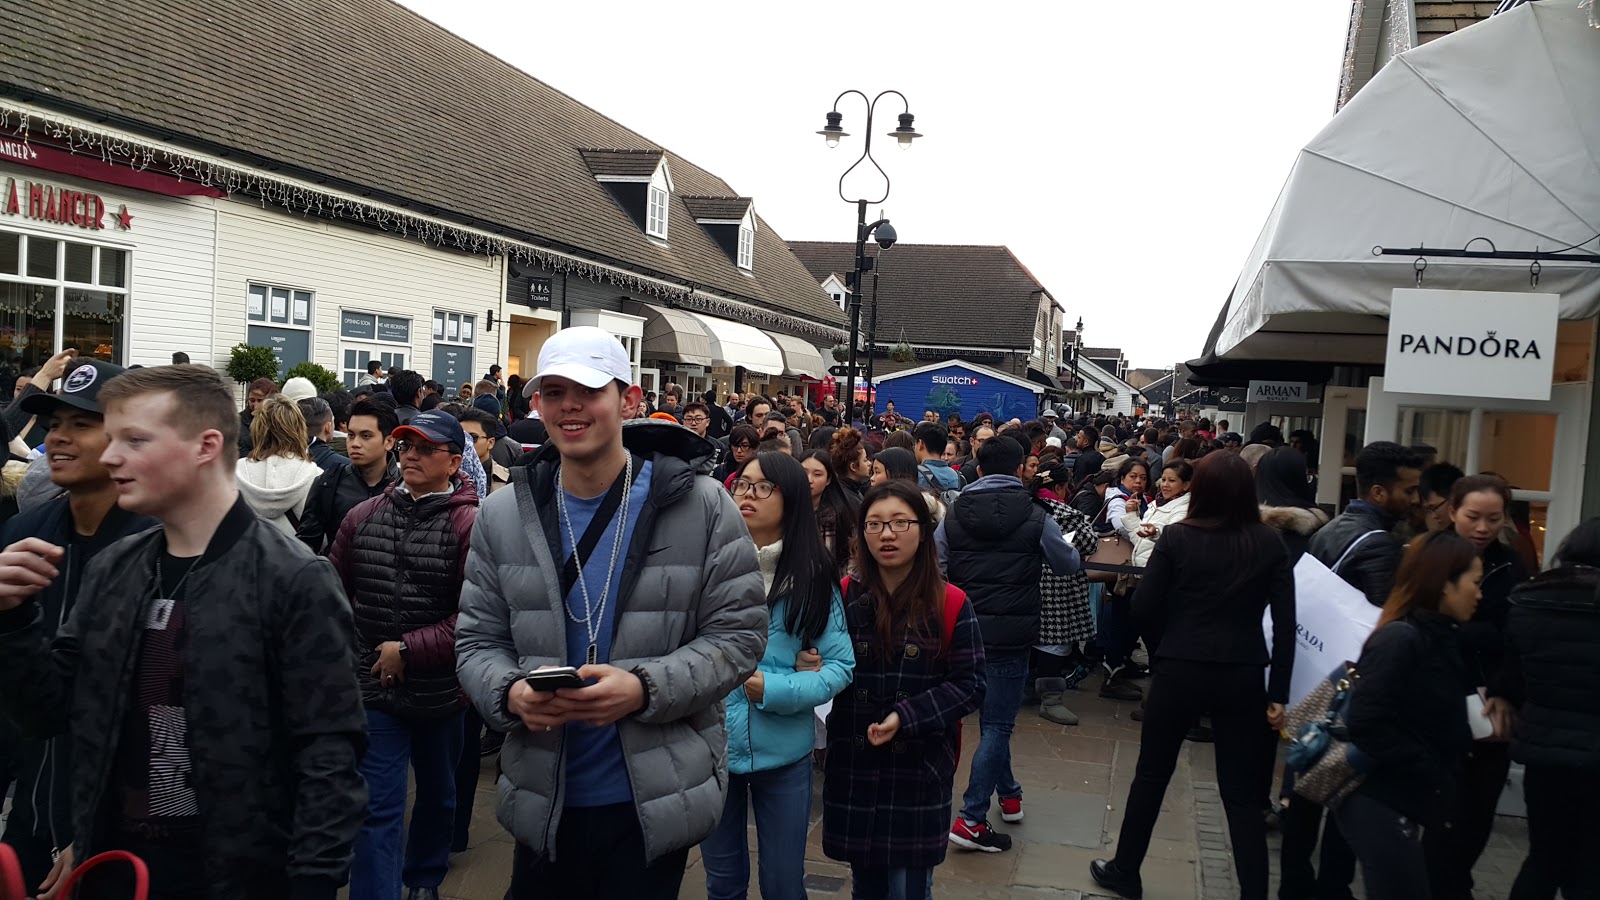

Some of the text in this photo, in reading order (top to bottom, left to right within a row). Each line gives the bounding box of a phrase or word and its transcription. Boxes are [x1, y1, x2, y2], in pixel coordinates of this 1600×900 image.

[6, 178, 105, 229] A MANGER
[1399, 331, 1541, 360] PANDORA
[931, 375, 971, 385] swatch
[1255, 385, 1301, 398] ARMANI
[1295, 623, 1324, 653] RADA
